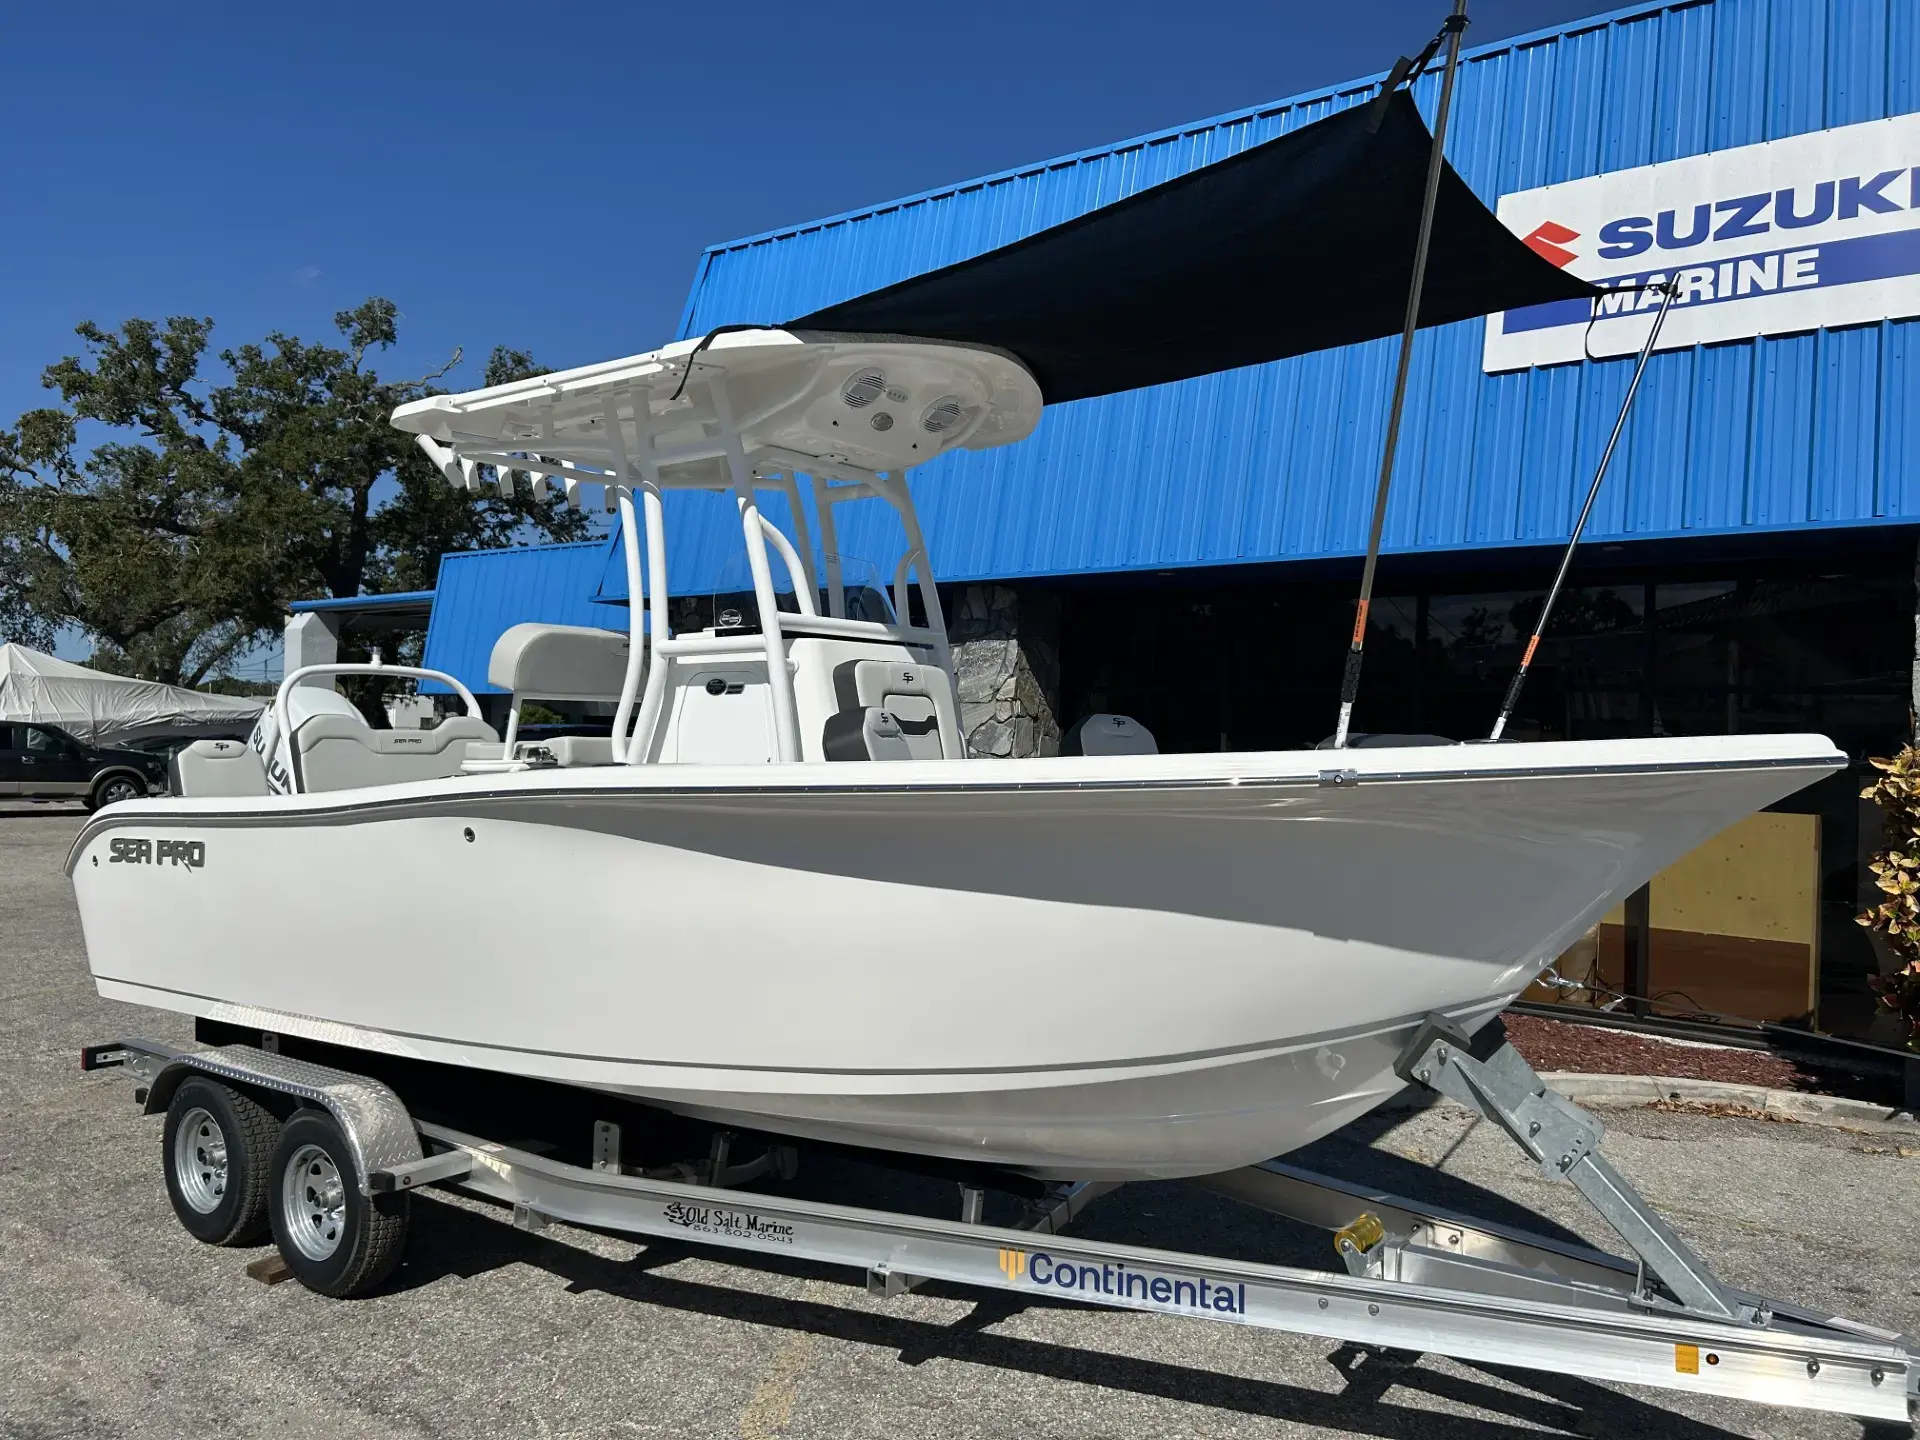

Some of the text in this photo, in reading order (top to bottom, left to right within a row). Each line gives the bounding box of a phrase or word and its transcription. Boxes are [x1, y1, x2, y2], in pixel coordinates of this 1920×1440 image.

[1590, 248, 1819, 318] MARINE
[108, 837, 206, 874] SEA PRO
[686, 1206, 794, 1236] Old Salt Marine
[1029, 1253, 1246, 1315] Continental
